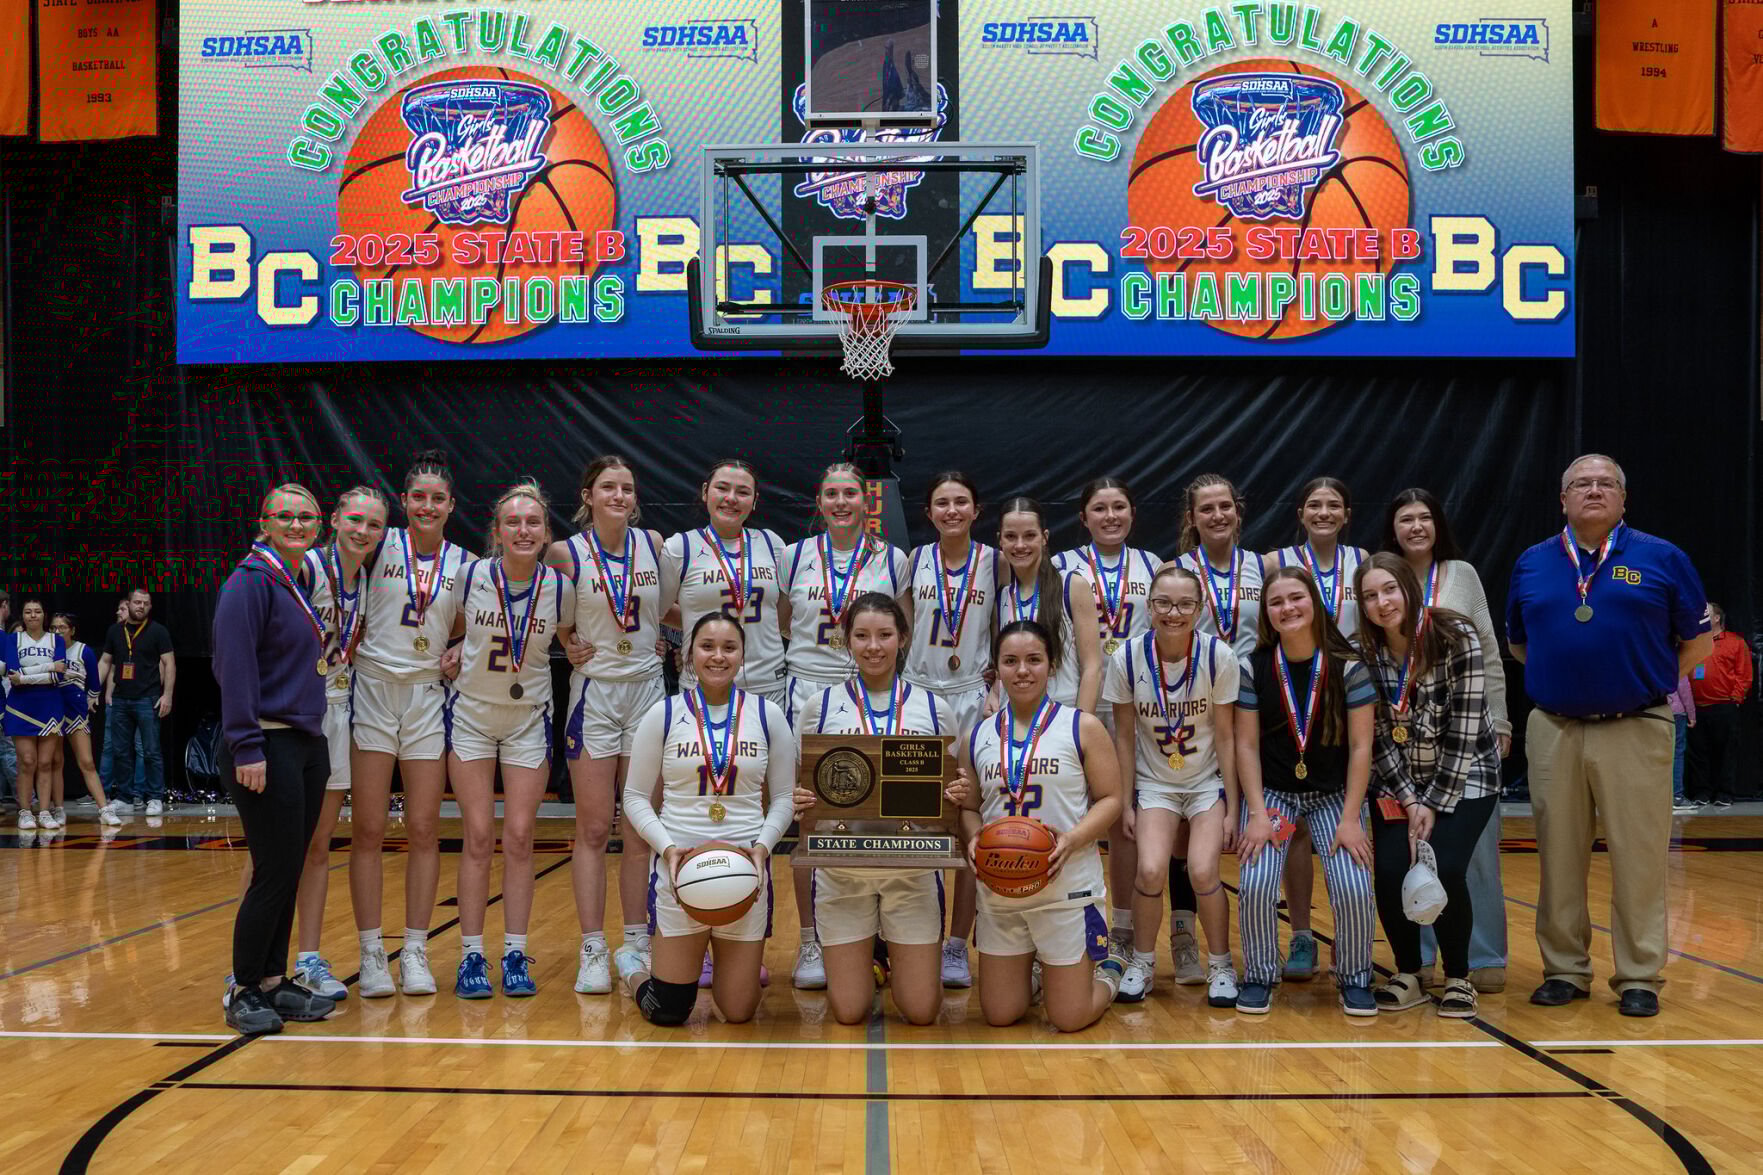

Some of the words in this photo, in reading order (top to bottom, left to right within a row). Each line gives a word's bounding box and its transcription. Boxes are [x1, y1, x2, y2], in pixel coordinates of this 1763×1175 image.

[77, 28, 98, 38] BOYS
[107, 27, 120, 37] AA
[982, 22, 1089, 43] SDHSAA
[1651, 18, 1658, 28] A
[642, 25, 749, 46] SDHSAA
[1434, 24, 1540, 44] SDHSAA
[201, 35, 304, 57] SDHSAA
[72, 60, 126, 71] BASKETBALL
[1641, 67, 1667, 77] 1994
[287, 7, 671, 173] CONGRATULATIONS
[450, 87, 497, 98] SDHSAA
[1073, 1, 1465, 171] CONGRATULATIONS
[1241, 80, 1289, 91] SDHSAA
[87, 93, 112, 103] 1993
[410, 119, 546, 189] Basketball
[1202, 113, 1338, 182] Basketball
[427, 172, 524, 206] CHAMPIONSHIP
[822, 171, 921, 200] CHAMPONSHIP
[1220, 168, 1318, 200] CHAMPIONSHIP
[461, 193, 488, 210] 2025
[1254, 187, 1281, 205] 2025
[330, 233, 440, 266] 2025
[452, 231, 592, 264] STATE
[596, 231, 626, 263] B
[1120, 226, 1233, 259] 2025
[1247, 227, 1380, 260] STATE
[1391, 228, 1421, 259] B
[330, 274, 625, 327] CHAMPIONS
[1120, 271, 1421, 324] CHAMPIONS
[708, 326, 741, 335] SPALDING
[1612, 566, 1641, 585] BC
[19, 646, 55, 659] BCHS
[885, 750, 940, 758] BASKETBALL
[900, 743, 926, 751] GIRLS
[817, 839, 857, 849] STATE
[863, 839, 942, 850] CHAMPIONS
[696, 858, 728, 870] SDHSAA
